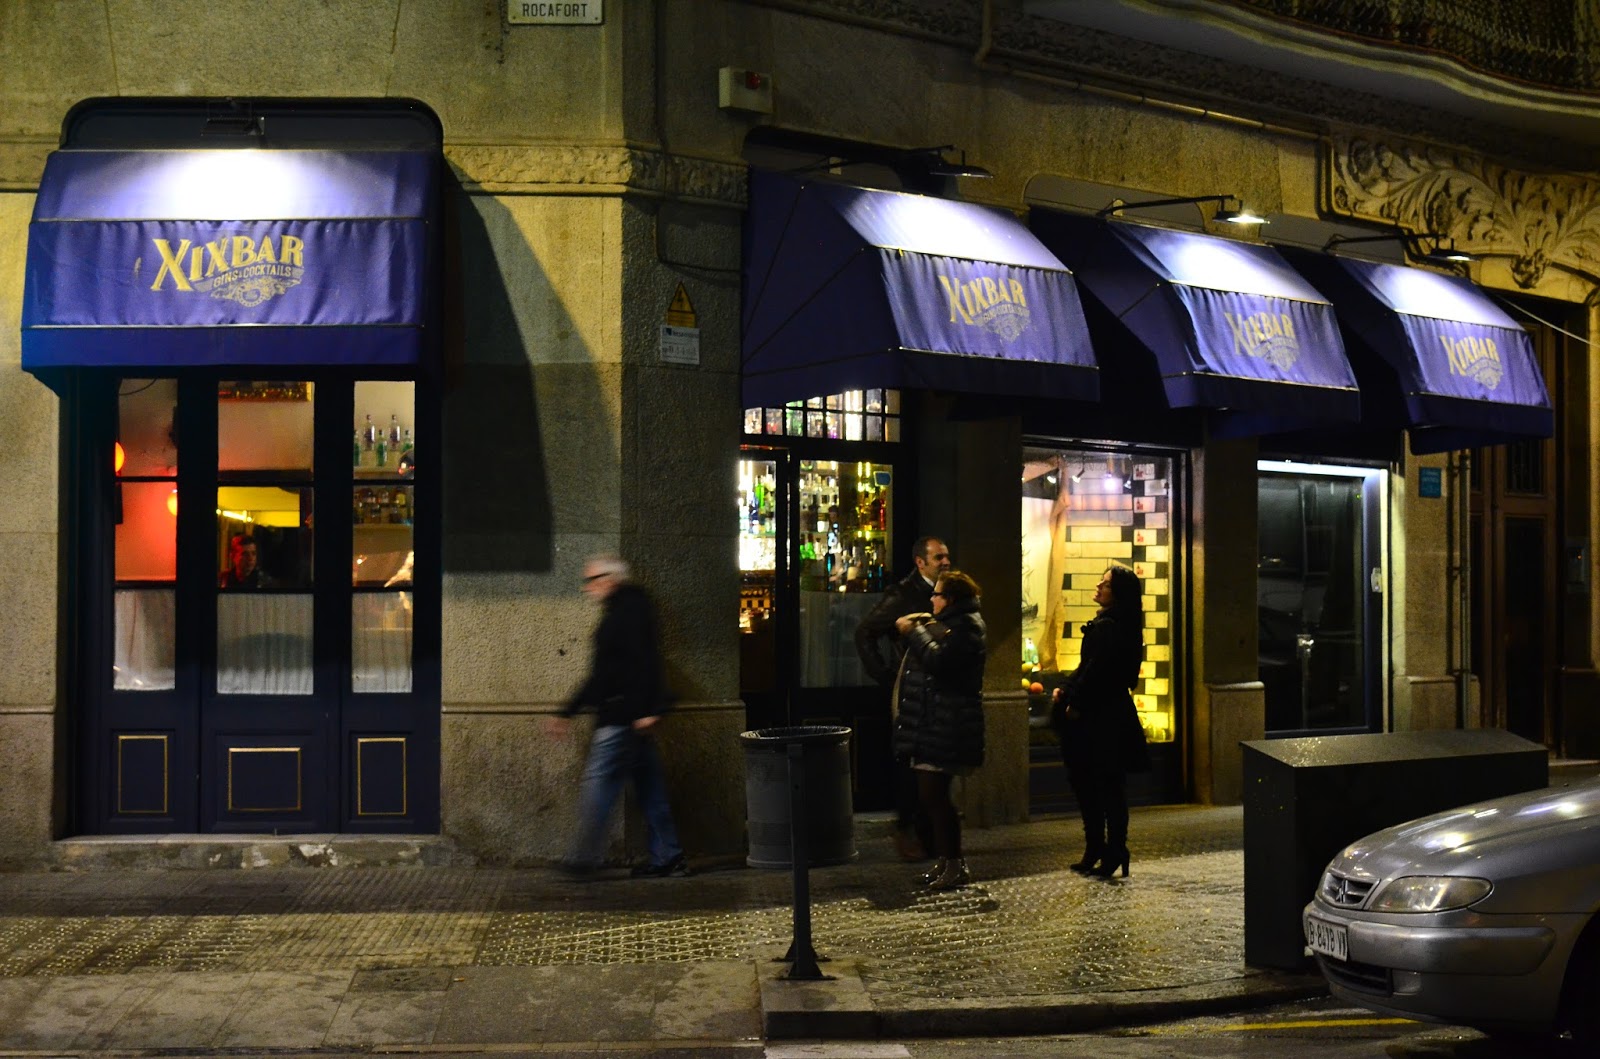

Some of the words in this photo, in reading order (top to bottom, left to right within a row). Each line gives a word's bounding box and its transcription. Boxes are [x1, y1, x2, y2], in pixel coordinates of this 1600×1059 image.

[522, 3, 588, 17] ROCAFORT
[150, 234, 305, 292] XIXBAR
[938, 275, 1027, 326] XIXBAR
[1224, 311, 1296, 357] XIXBAR
[1440, 335, 1500, 377] XIXBAR
